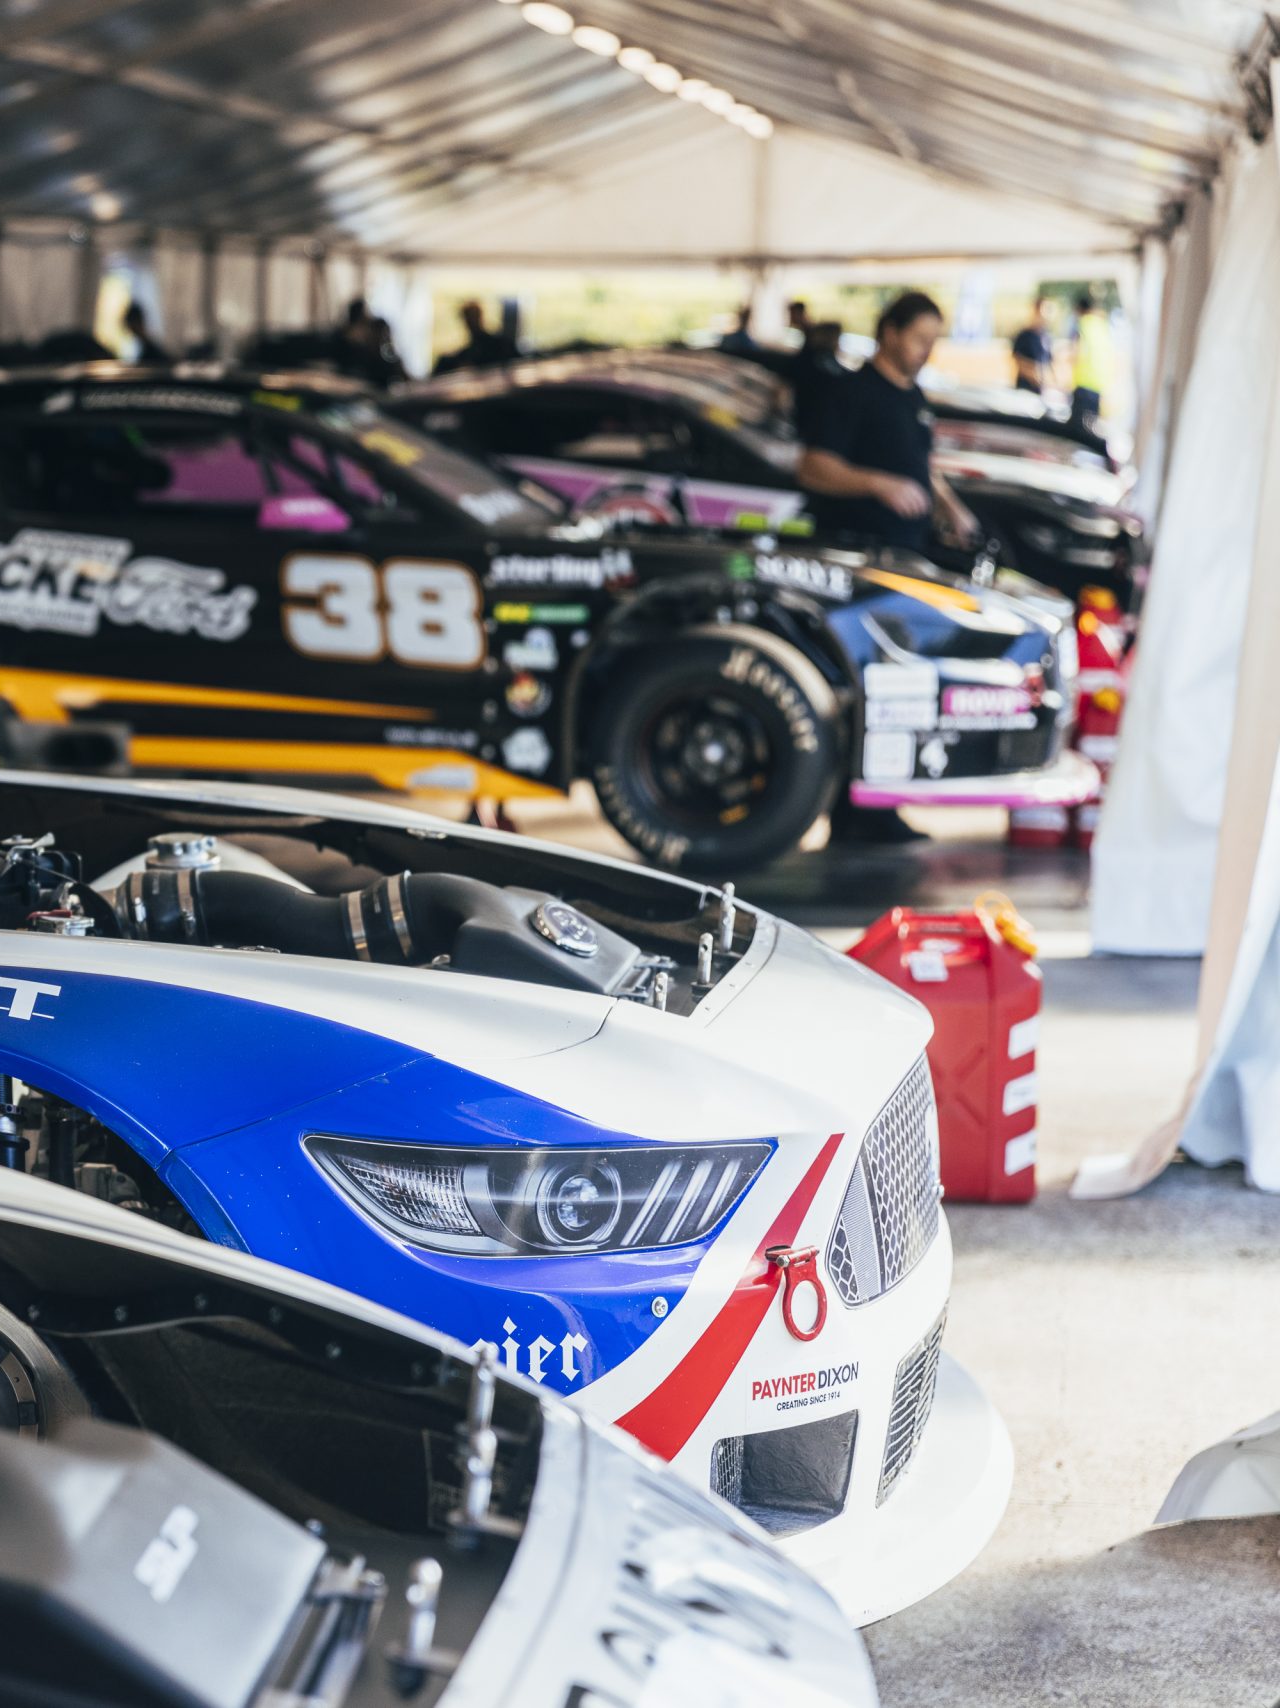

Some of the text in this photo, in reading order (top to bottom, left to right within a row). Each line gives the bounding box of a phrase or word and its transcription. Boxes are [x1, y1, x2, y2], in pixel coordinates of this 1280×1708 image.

[281, 551, 486, 670] 38
[470, 1316, 588, 1384] ier
[752, 1361, 859, 1401] PAYNTER DIXON
[776, 1398, 808, 1411] CREATING
[810, 1393, 826, 1405] SINCE
